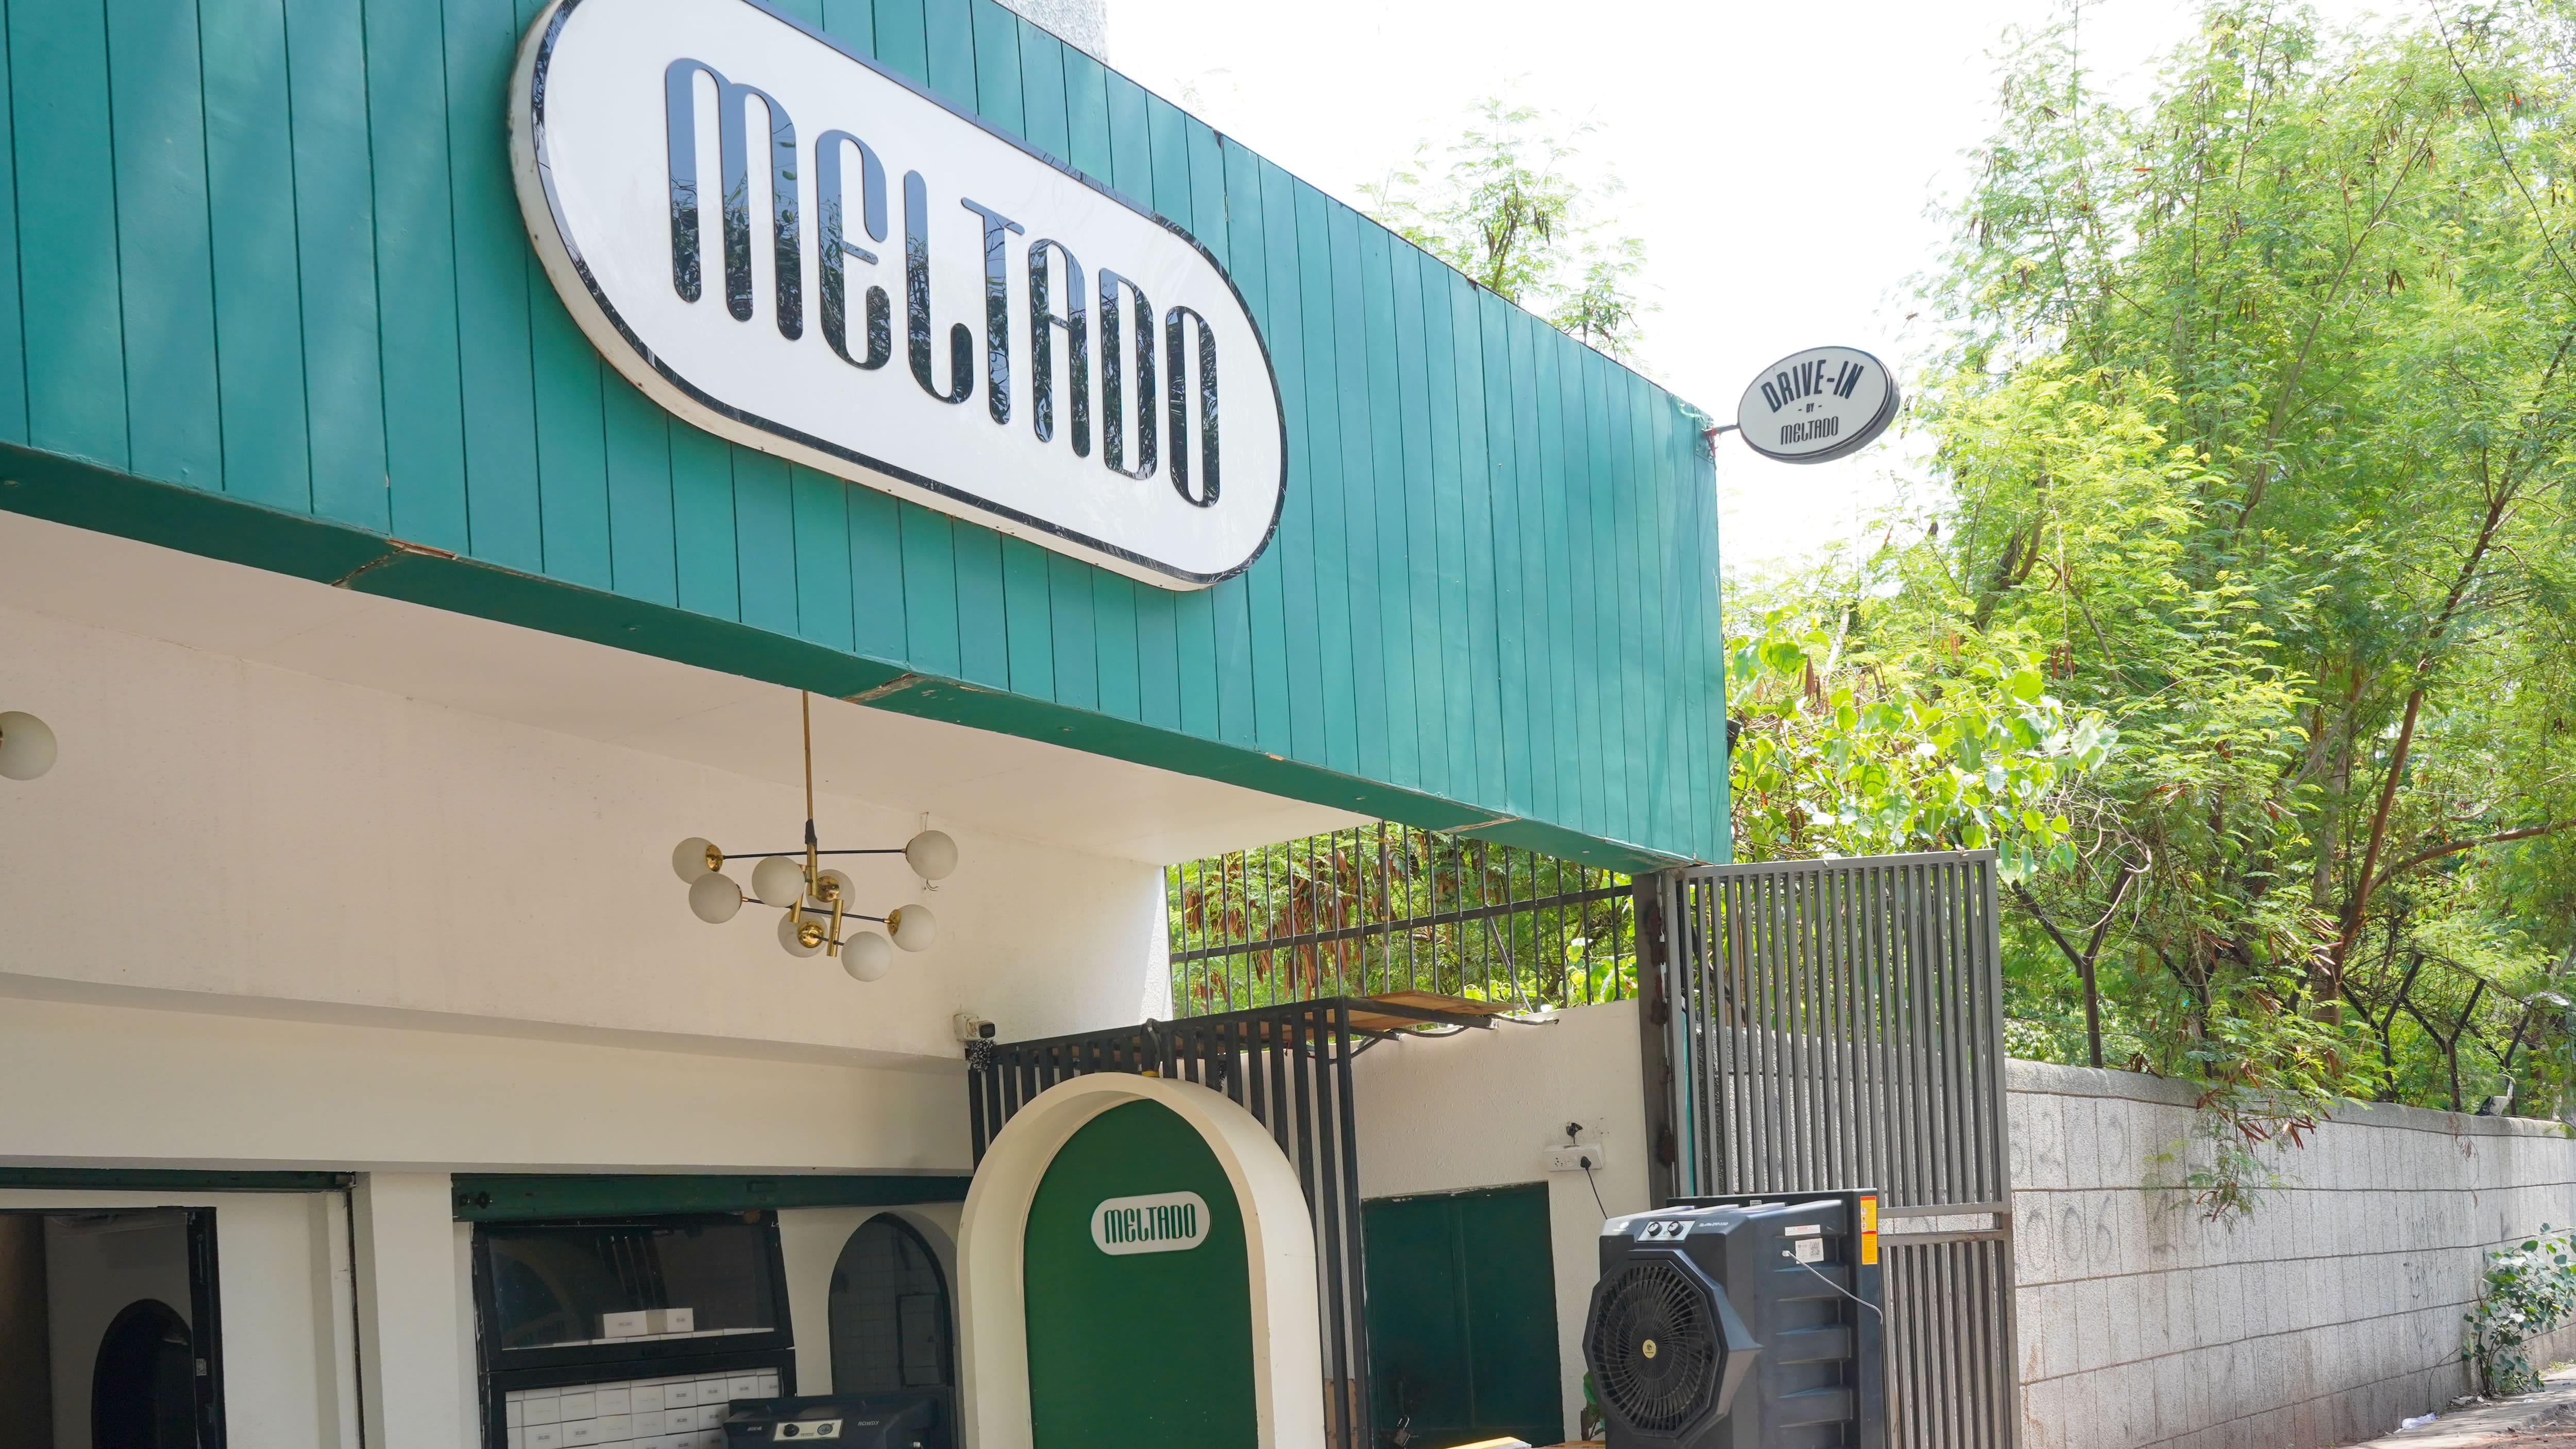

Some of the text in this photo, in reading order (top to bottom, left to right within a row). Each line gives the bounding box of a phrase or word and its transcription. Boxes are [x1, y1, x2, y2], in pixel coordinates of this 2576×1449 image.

[665, 58, 1221, 508] MELTADO
[1760, 359, 1865, 413] DRIVE-IN
[1781, 416, 1839, 445] MELTADO
[1104, 1203, 1196, 1244] MELTADO
